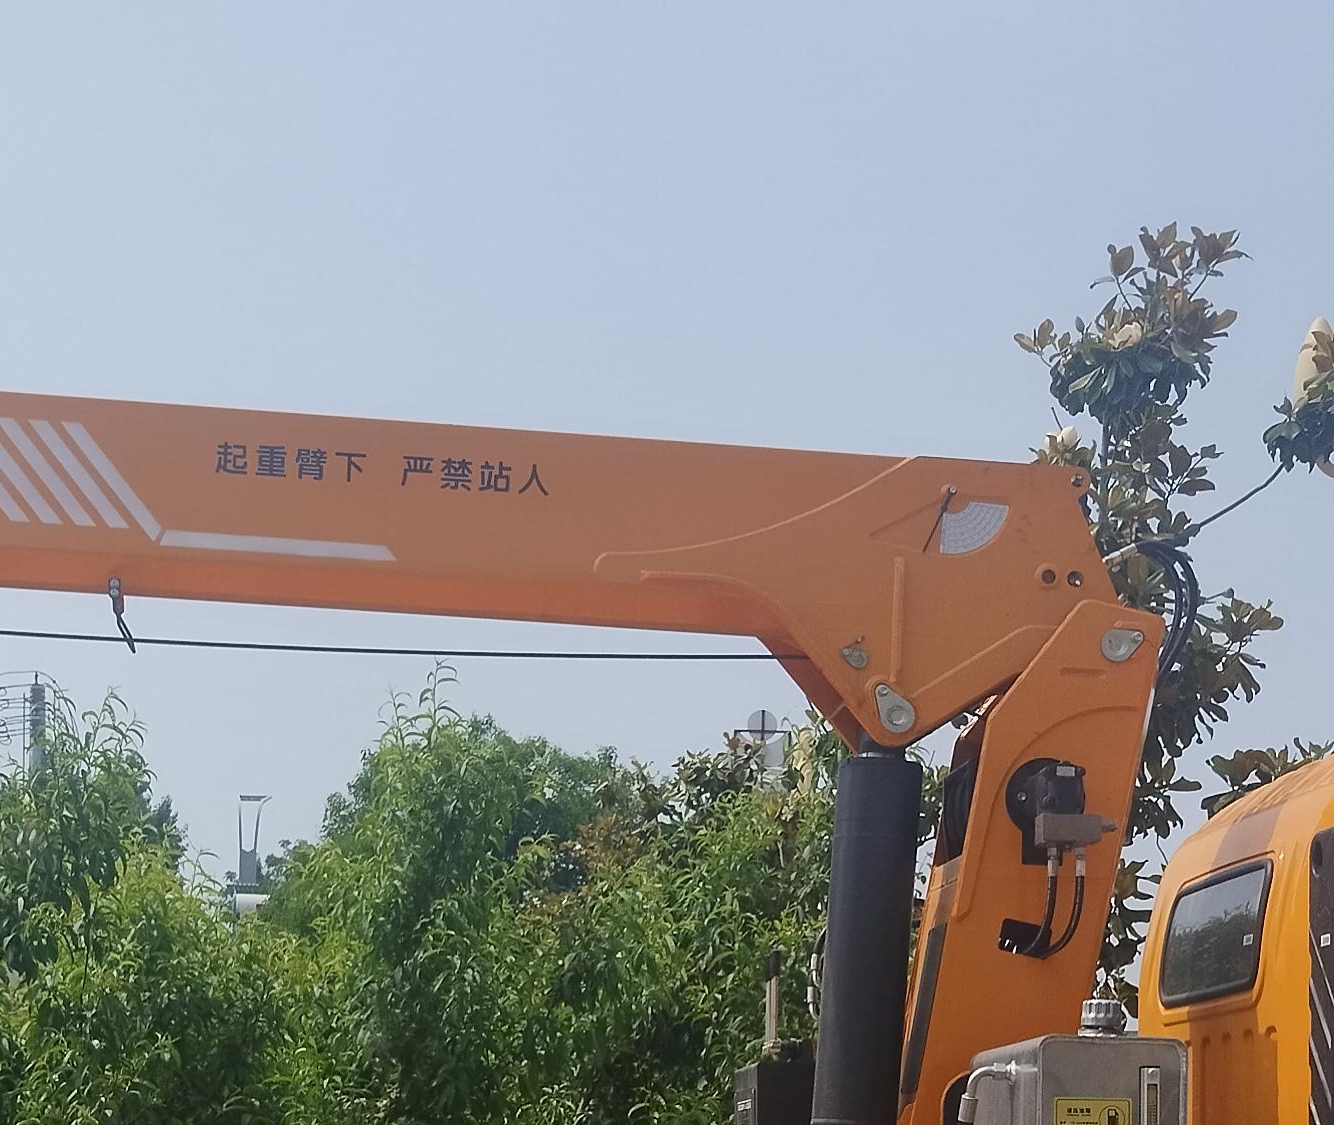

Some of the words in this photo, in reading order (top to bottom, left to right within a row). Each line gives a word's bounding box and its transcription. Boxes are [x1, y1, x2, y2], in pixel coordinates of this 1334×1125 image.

[215, 441, 367, 483] 起重臂下
[400, 455, 549, 497] 严禁站人
